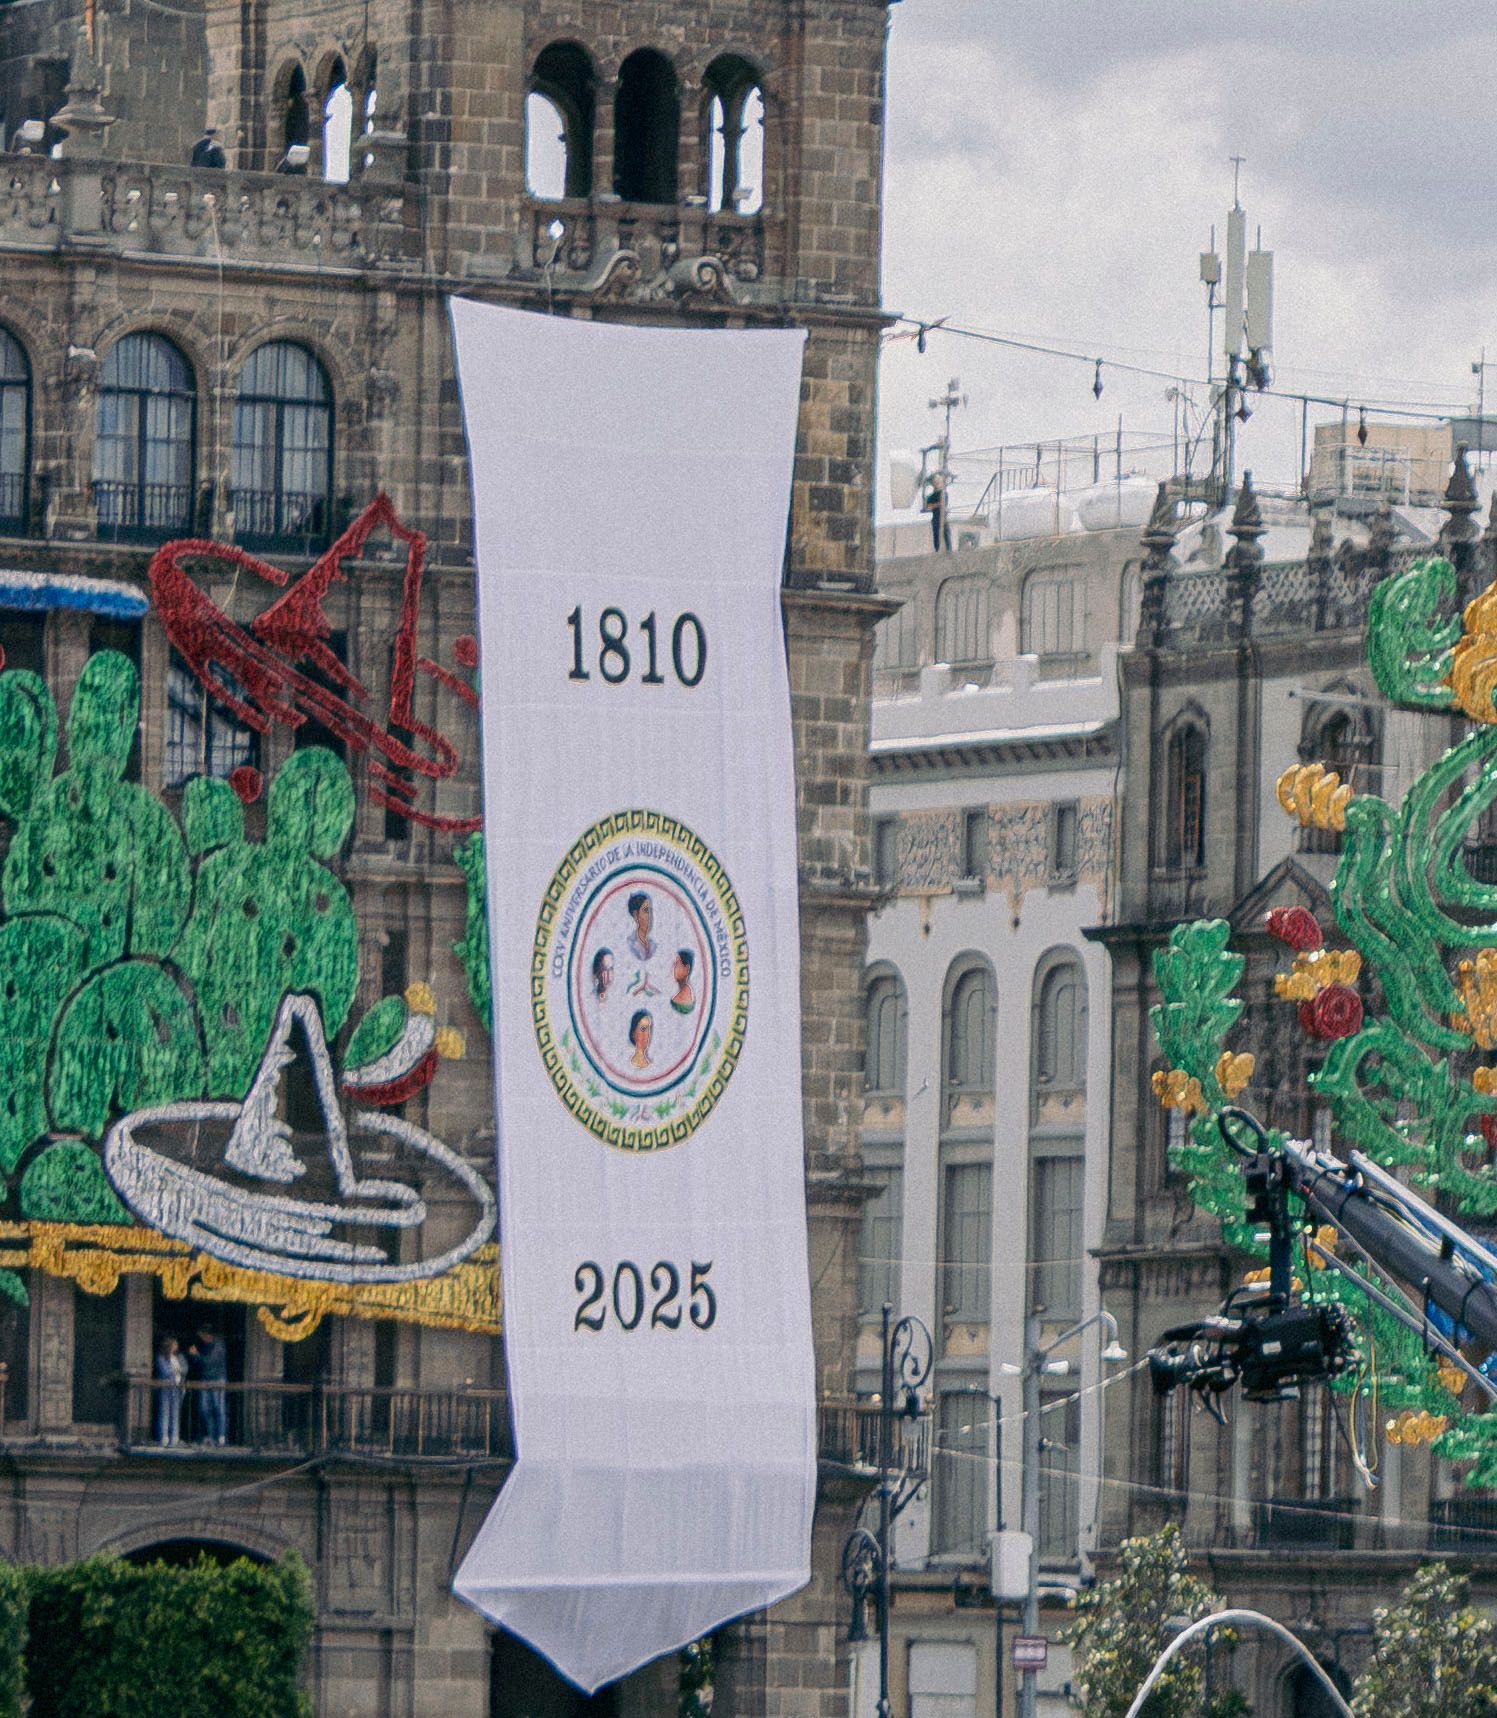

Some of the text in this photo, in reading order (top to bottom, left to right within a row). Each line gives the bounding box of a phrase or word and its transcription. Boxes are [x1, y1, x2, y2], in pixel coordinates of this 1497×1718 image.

[565, 604, 707, 687] 1810
[606, 847, 623, 865] DE
[636, 841, 708, 901] INDEPENDENCIA
[574, 1259, 717, 1332] 2025
